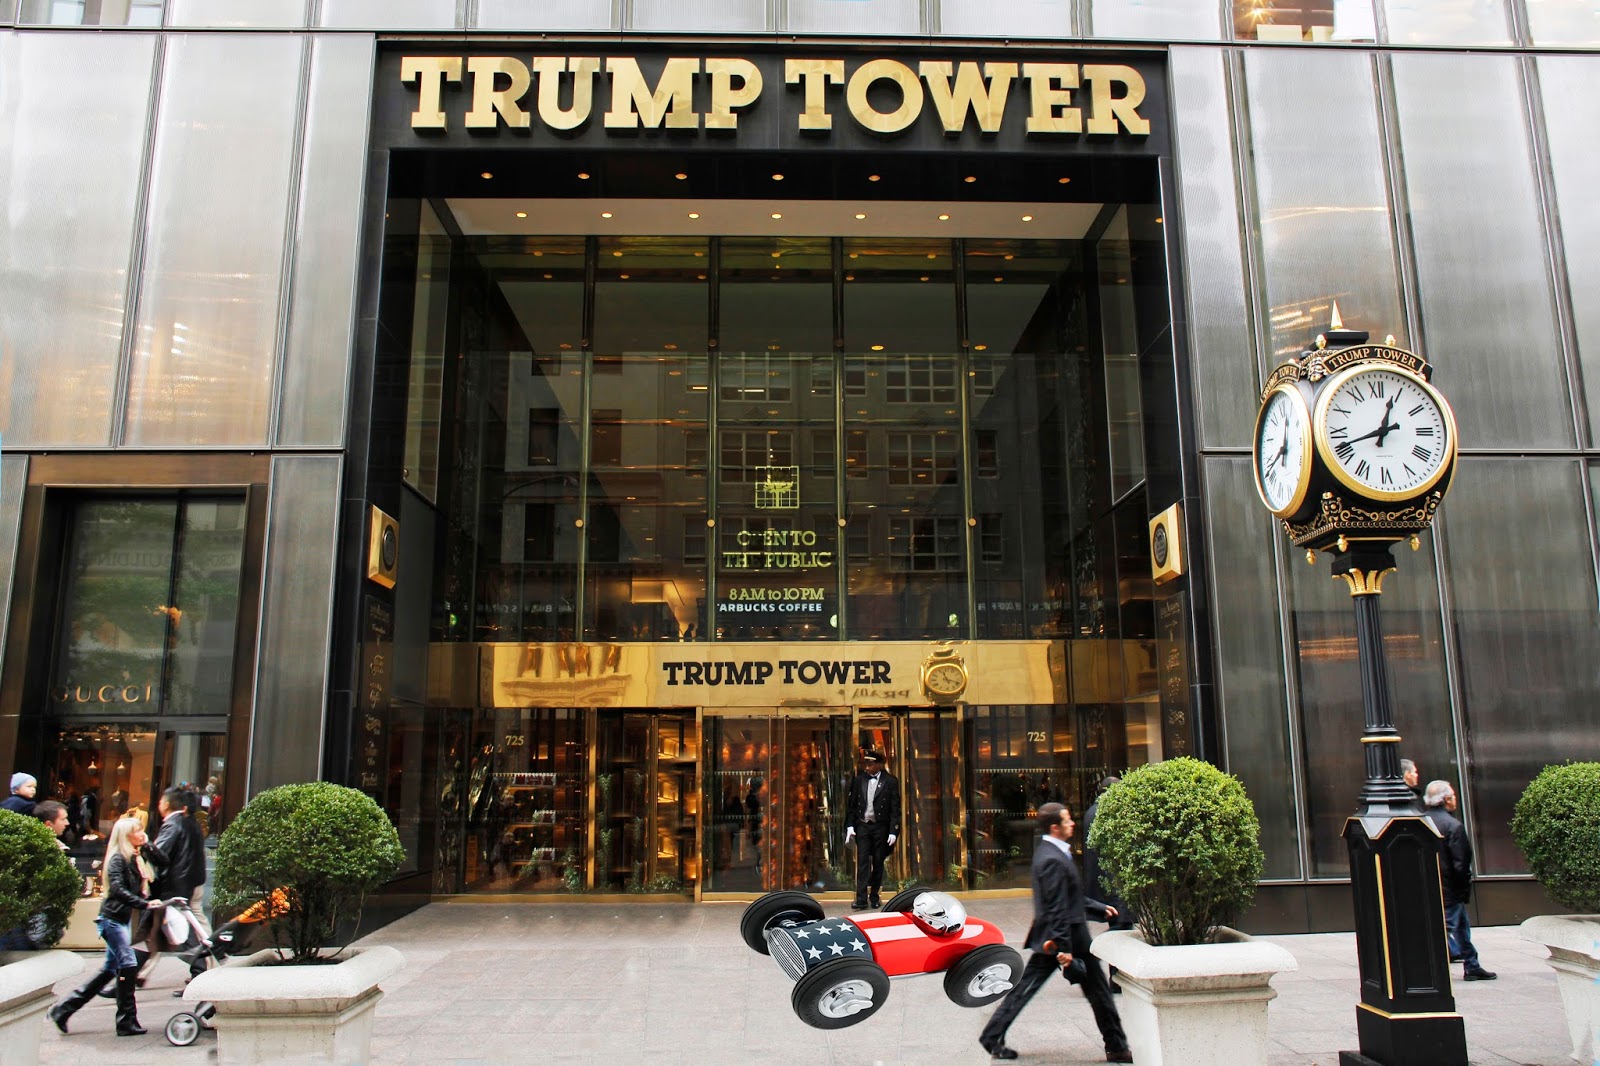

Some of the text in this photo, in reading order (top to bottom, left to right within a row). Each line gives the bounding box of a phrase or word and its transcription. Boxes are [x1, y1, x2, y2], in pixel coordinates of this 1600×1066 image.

[400, 56, 1151, 136] TRUMP TOWER
[1328, 348, 1416, 369] TRUMP TOWER
[736, 530, 816, 546] OEN TO
[764, 552, 832, 568] PUBLIC
[767, 588, 782, 601] to
[717, 603, 822, 612] ARBUCKS COFFEE
[662, 660, 892, 686] TRUMP TOWER
[505, 735, 524, 746] 725
[1027, 731, 1046, 742] 725
